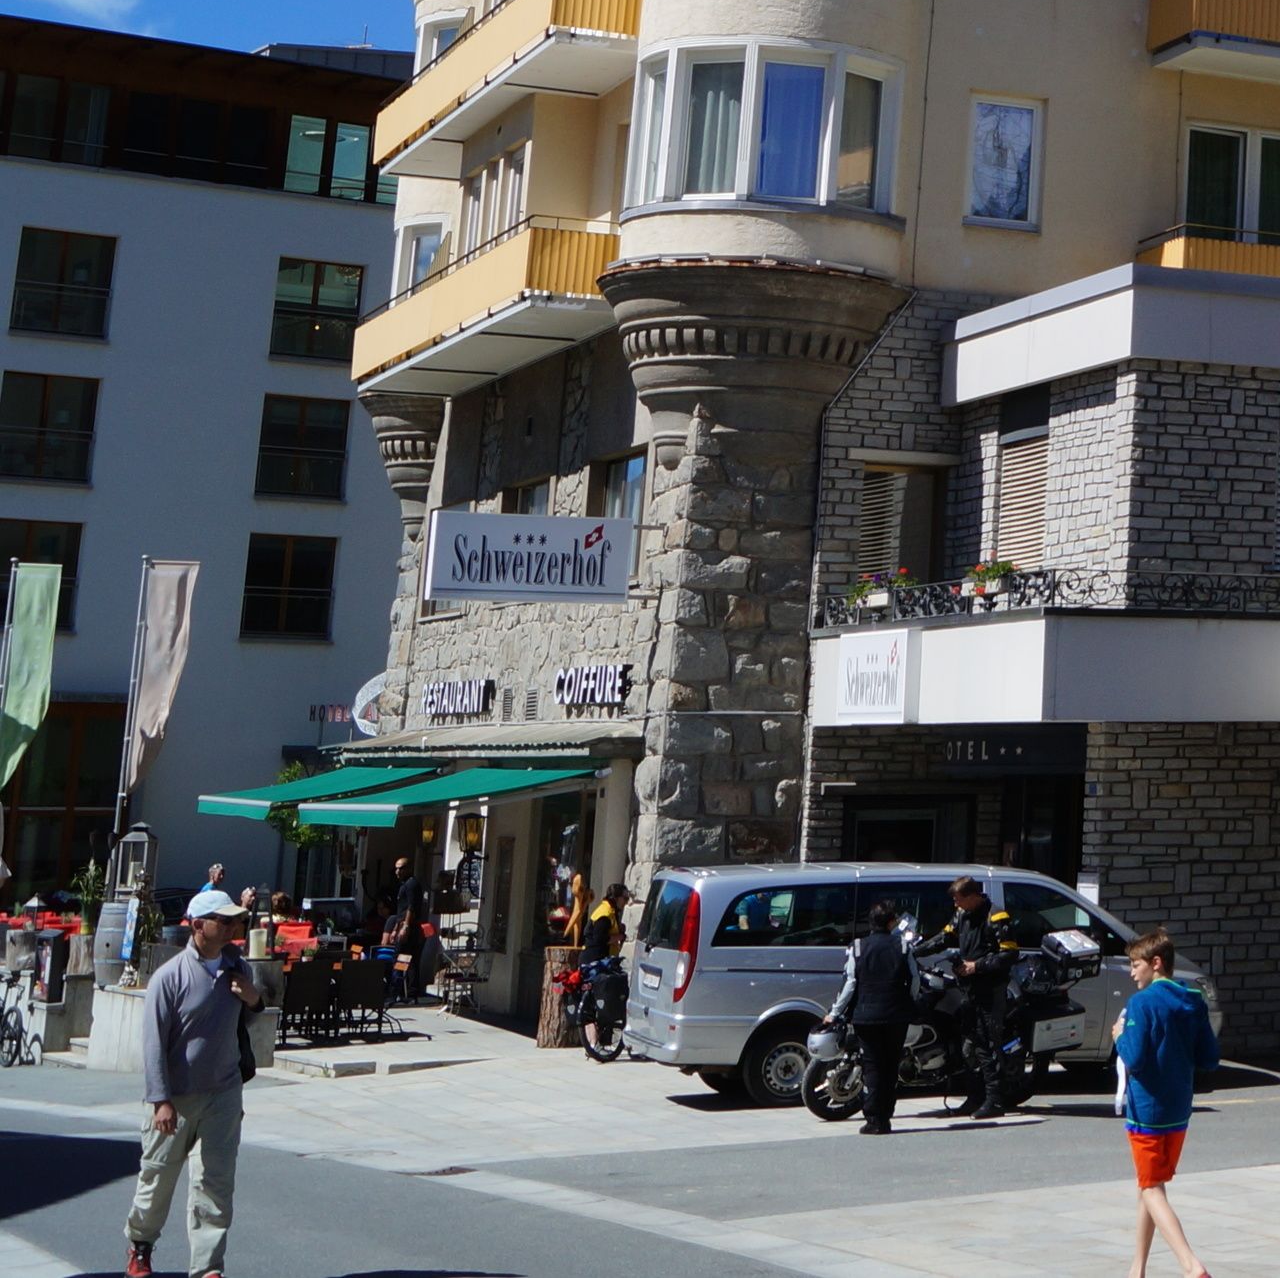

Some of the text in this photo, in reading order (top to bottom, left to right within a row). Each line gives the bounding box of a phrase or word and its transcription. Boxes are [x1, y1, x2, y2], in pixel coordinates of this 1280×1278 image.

[451, 532, 613, 587] Schweizerhof
[420, 679, 488, 715] RESTAURANT
[553, 664, 624, 705] COIFFURE
[845, 653, 901, 707] Schweizerhof
[309, 704, 351, 723] HOTEL
